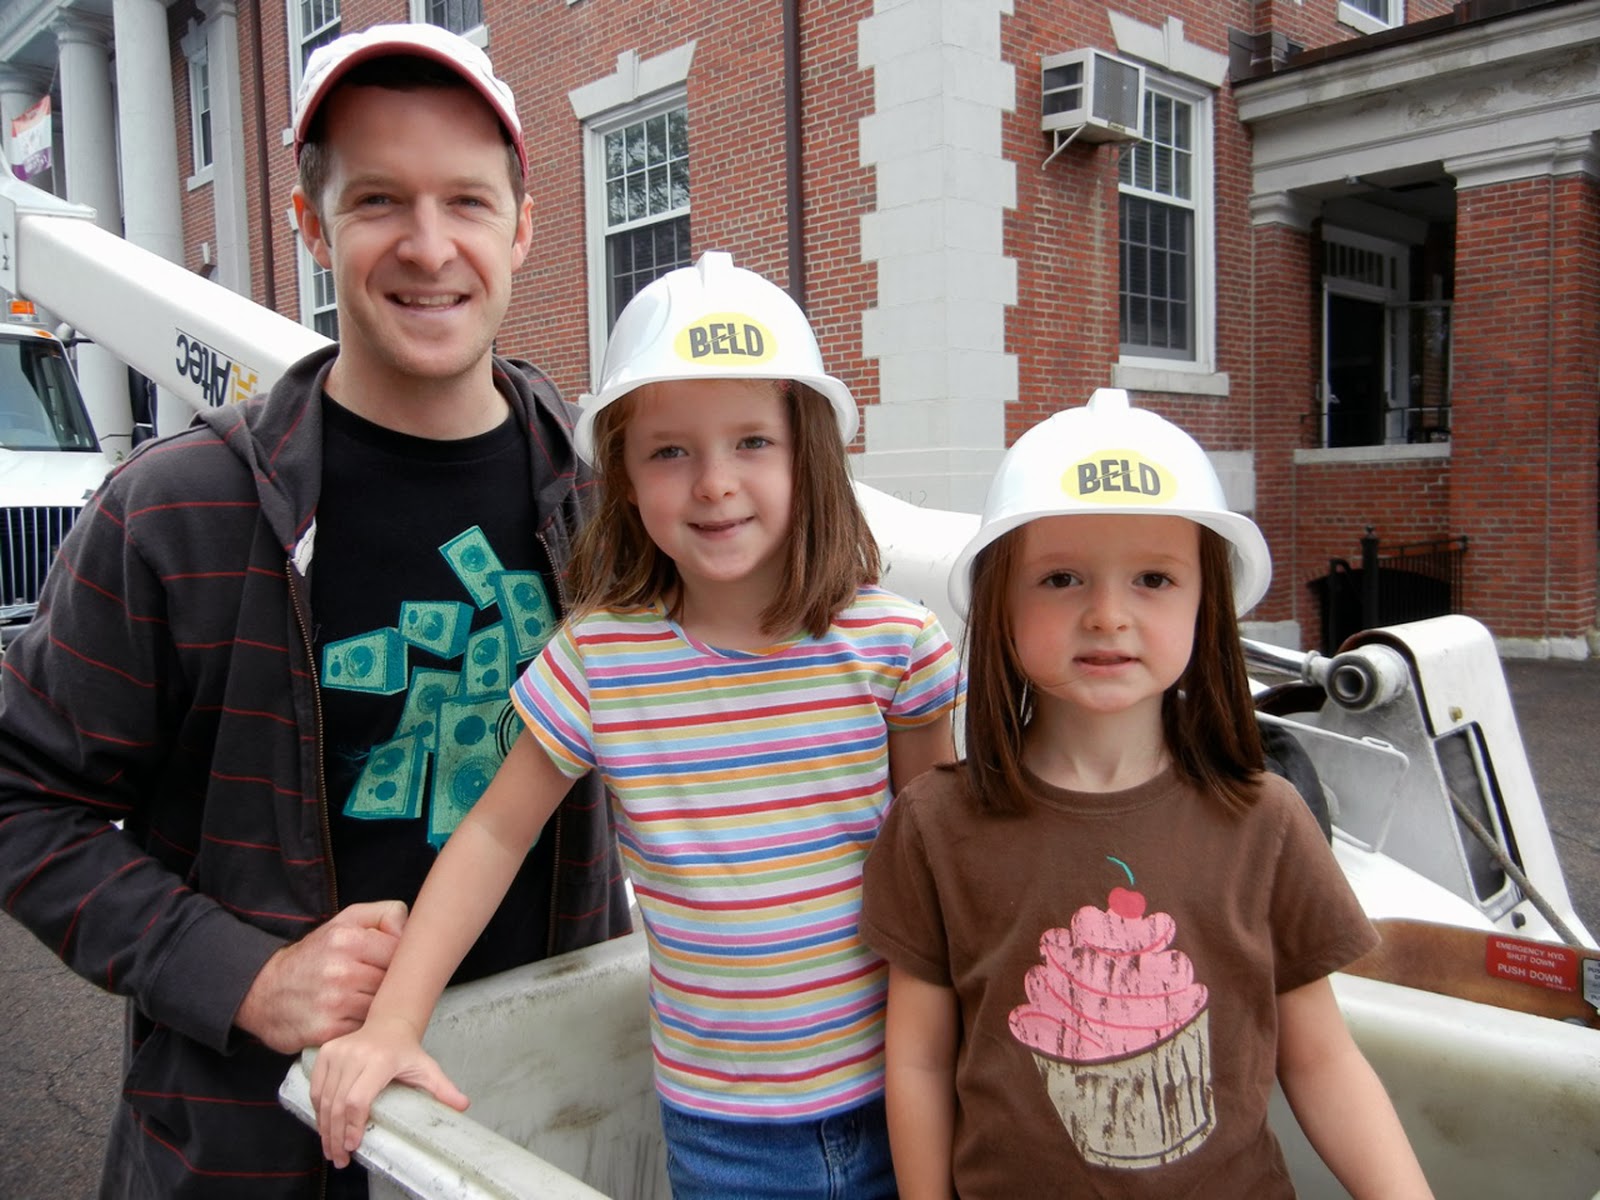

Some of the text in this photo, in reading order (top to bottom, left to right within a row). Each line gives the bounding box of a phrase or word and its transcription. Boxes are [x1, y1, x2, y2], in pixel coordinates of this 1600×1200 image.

[689, 323, 764, 358] BELD
[176, 334, 232, 408] Altec
[1077, 459, 1161, 496] BELD
[1496, 941, 1545, 956] EMERGENCY
[1506, 952, 1555, 968] SHUT DOWN
[1497, 963, 1563, 984] PUSH DOWN
